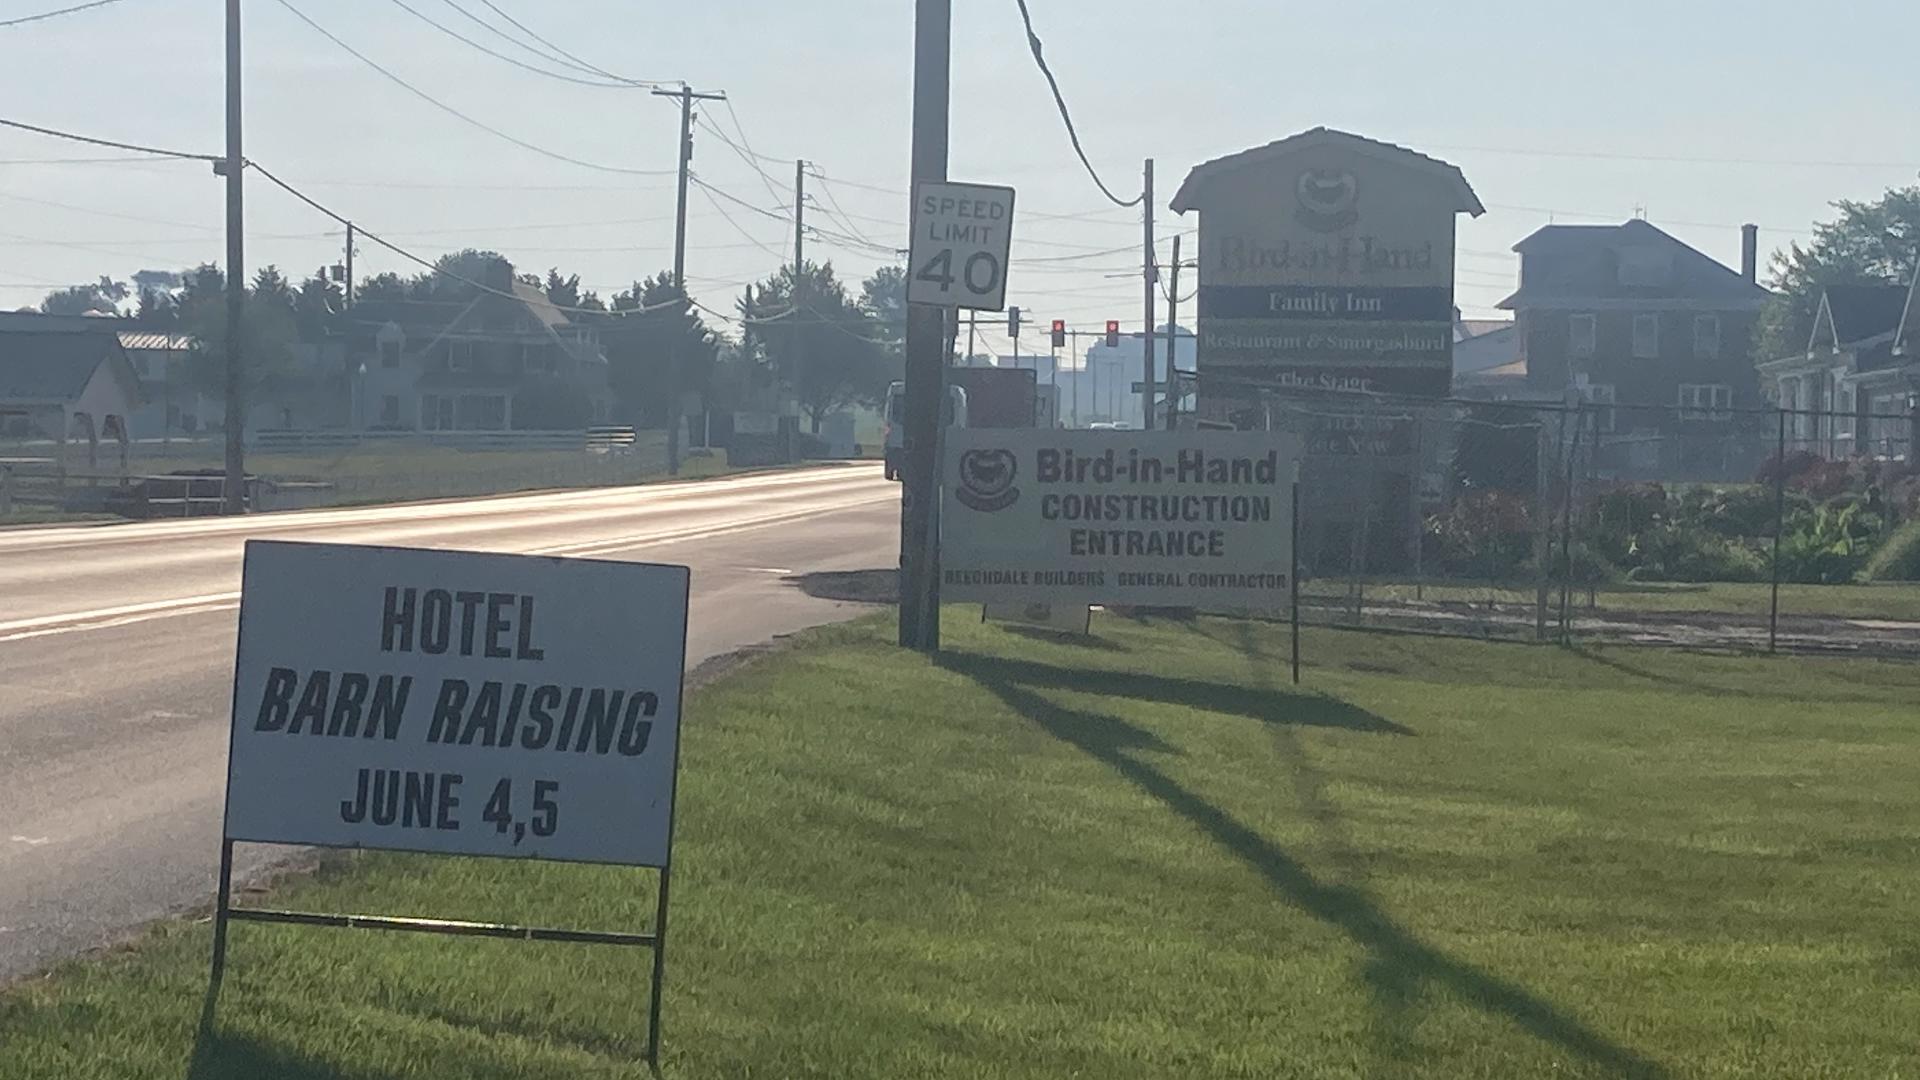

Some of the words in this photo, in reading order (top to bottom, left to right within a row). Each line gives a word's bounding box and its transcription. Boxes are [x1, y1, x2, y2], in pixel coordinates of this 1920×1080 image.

[923, 195, 1005, 220] SPEED
[930, 221, 993, 245] LIMIT
[1219, 235, 1433, 270] Bird-in-Hand
[915, 248, 1000, 295] 40
[1269, 291, 1340, 316] Family
[1346, 292, 1382, 313] Inn
[1203, 332, 1301, 350] Restaurant
[1305, 332, 1324, 350] &
[1275, 370, 1315, 387] The
[1319, 371, 1372, 393] Stage
[1035, 447, 1278, 484] Bird-in-Hand
[1041, 493, 1271, 522] CONSTRUCTION
[1069, 528, 1225, 557] ENTRANCE
[944, 569, 1029, 586] BEECHDALE
[1033, 570, 1106, 587] BUILDERS
[1117, 571, 1184, 588] GENERAL
[1187, 572, 1287, 589] CONTRACTOR
[380, 586, 545, 661] HOTEL
[253, 666, 413, 740] BARN
[426, 678, 660, 757] RAISING
[340, 767, 463, 831] JUNE
[481, 777, 560, 847] 4,5
